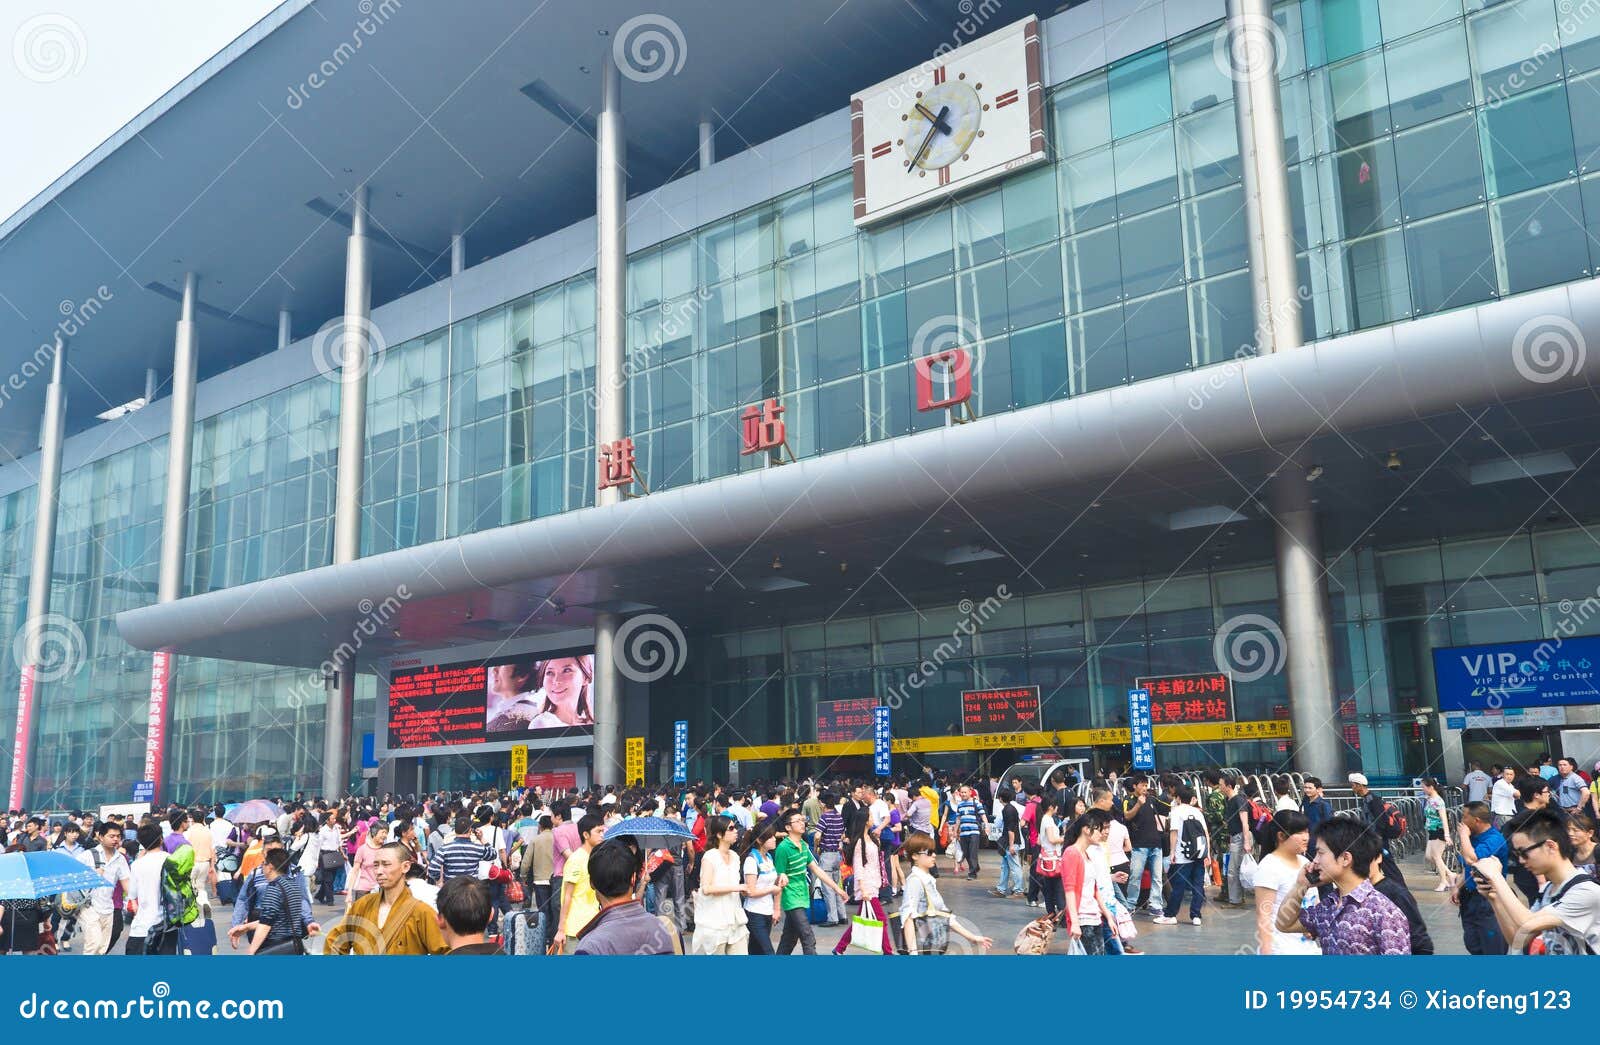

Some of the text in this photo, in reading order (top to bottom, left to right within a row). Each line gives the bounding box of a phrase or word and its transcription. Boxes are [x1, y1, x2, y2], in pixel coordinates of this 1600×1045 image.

[1461, 652, 1517, 676] VIP
[1142, 675, 1226, 696] 开车前2小时
[1474, 677, 1493, 686] VIP
[1552, 672, 1594, 681] Center
[1099, 729, 1127, 738] 安全检
[1138, 693, 1152, 763] 依次排队进站
[1235, 722, 1278, 732] 安全检查
